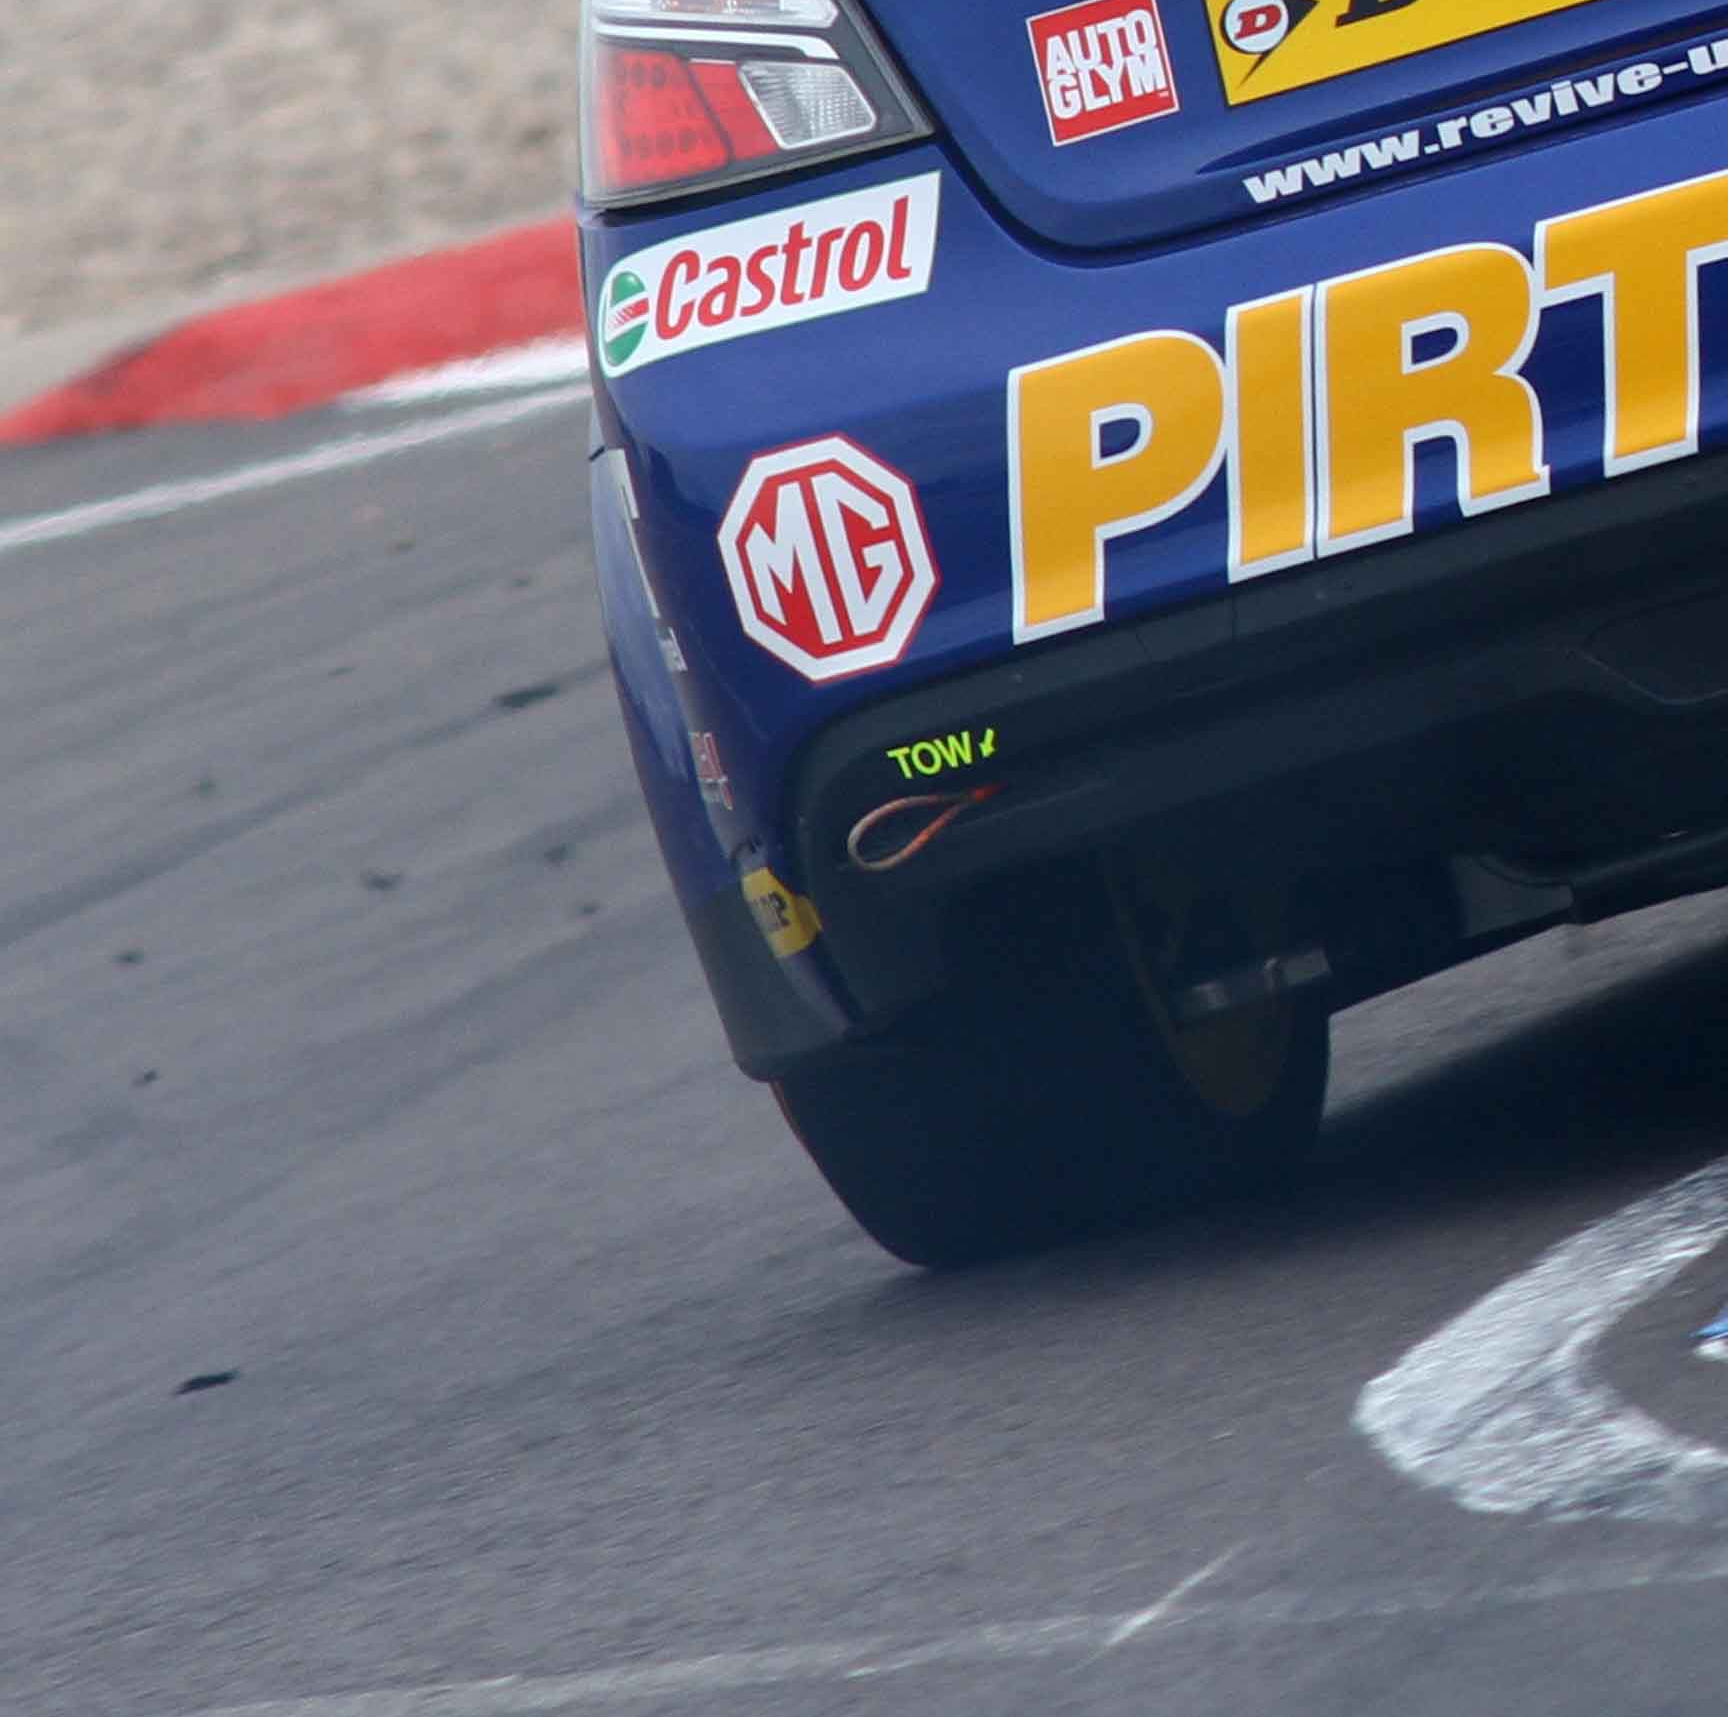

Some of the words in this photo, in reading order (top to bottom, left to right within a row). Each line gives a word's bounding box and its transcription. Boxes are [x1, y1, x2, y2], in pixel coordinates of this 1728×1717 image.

[1046, 8, 1153, 79] AUTO
[1048, 43, 1168, 122] GLYM
[655, 194, 912, 342] Castrol
[742, 463, 913, 652] MG
[887, 729, 975, 782] TOW
